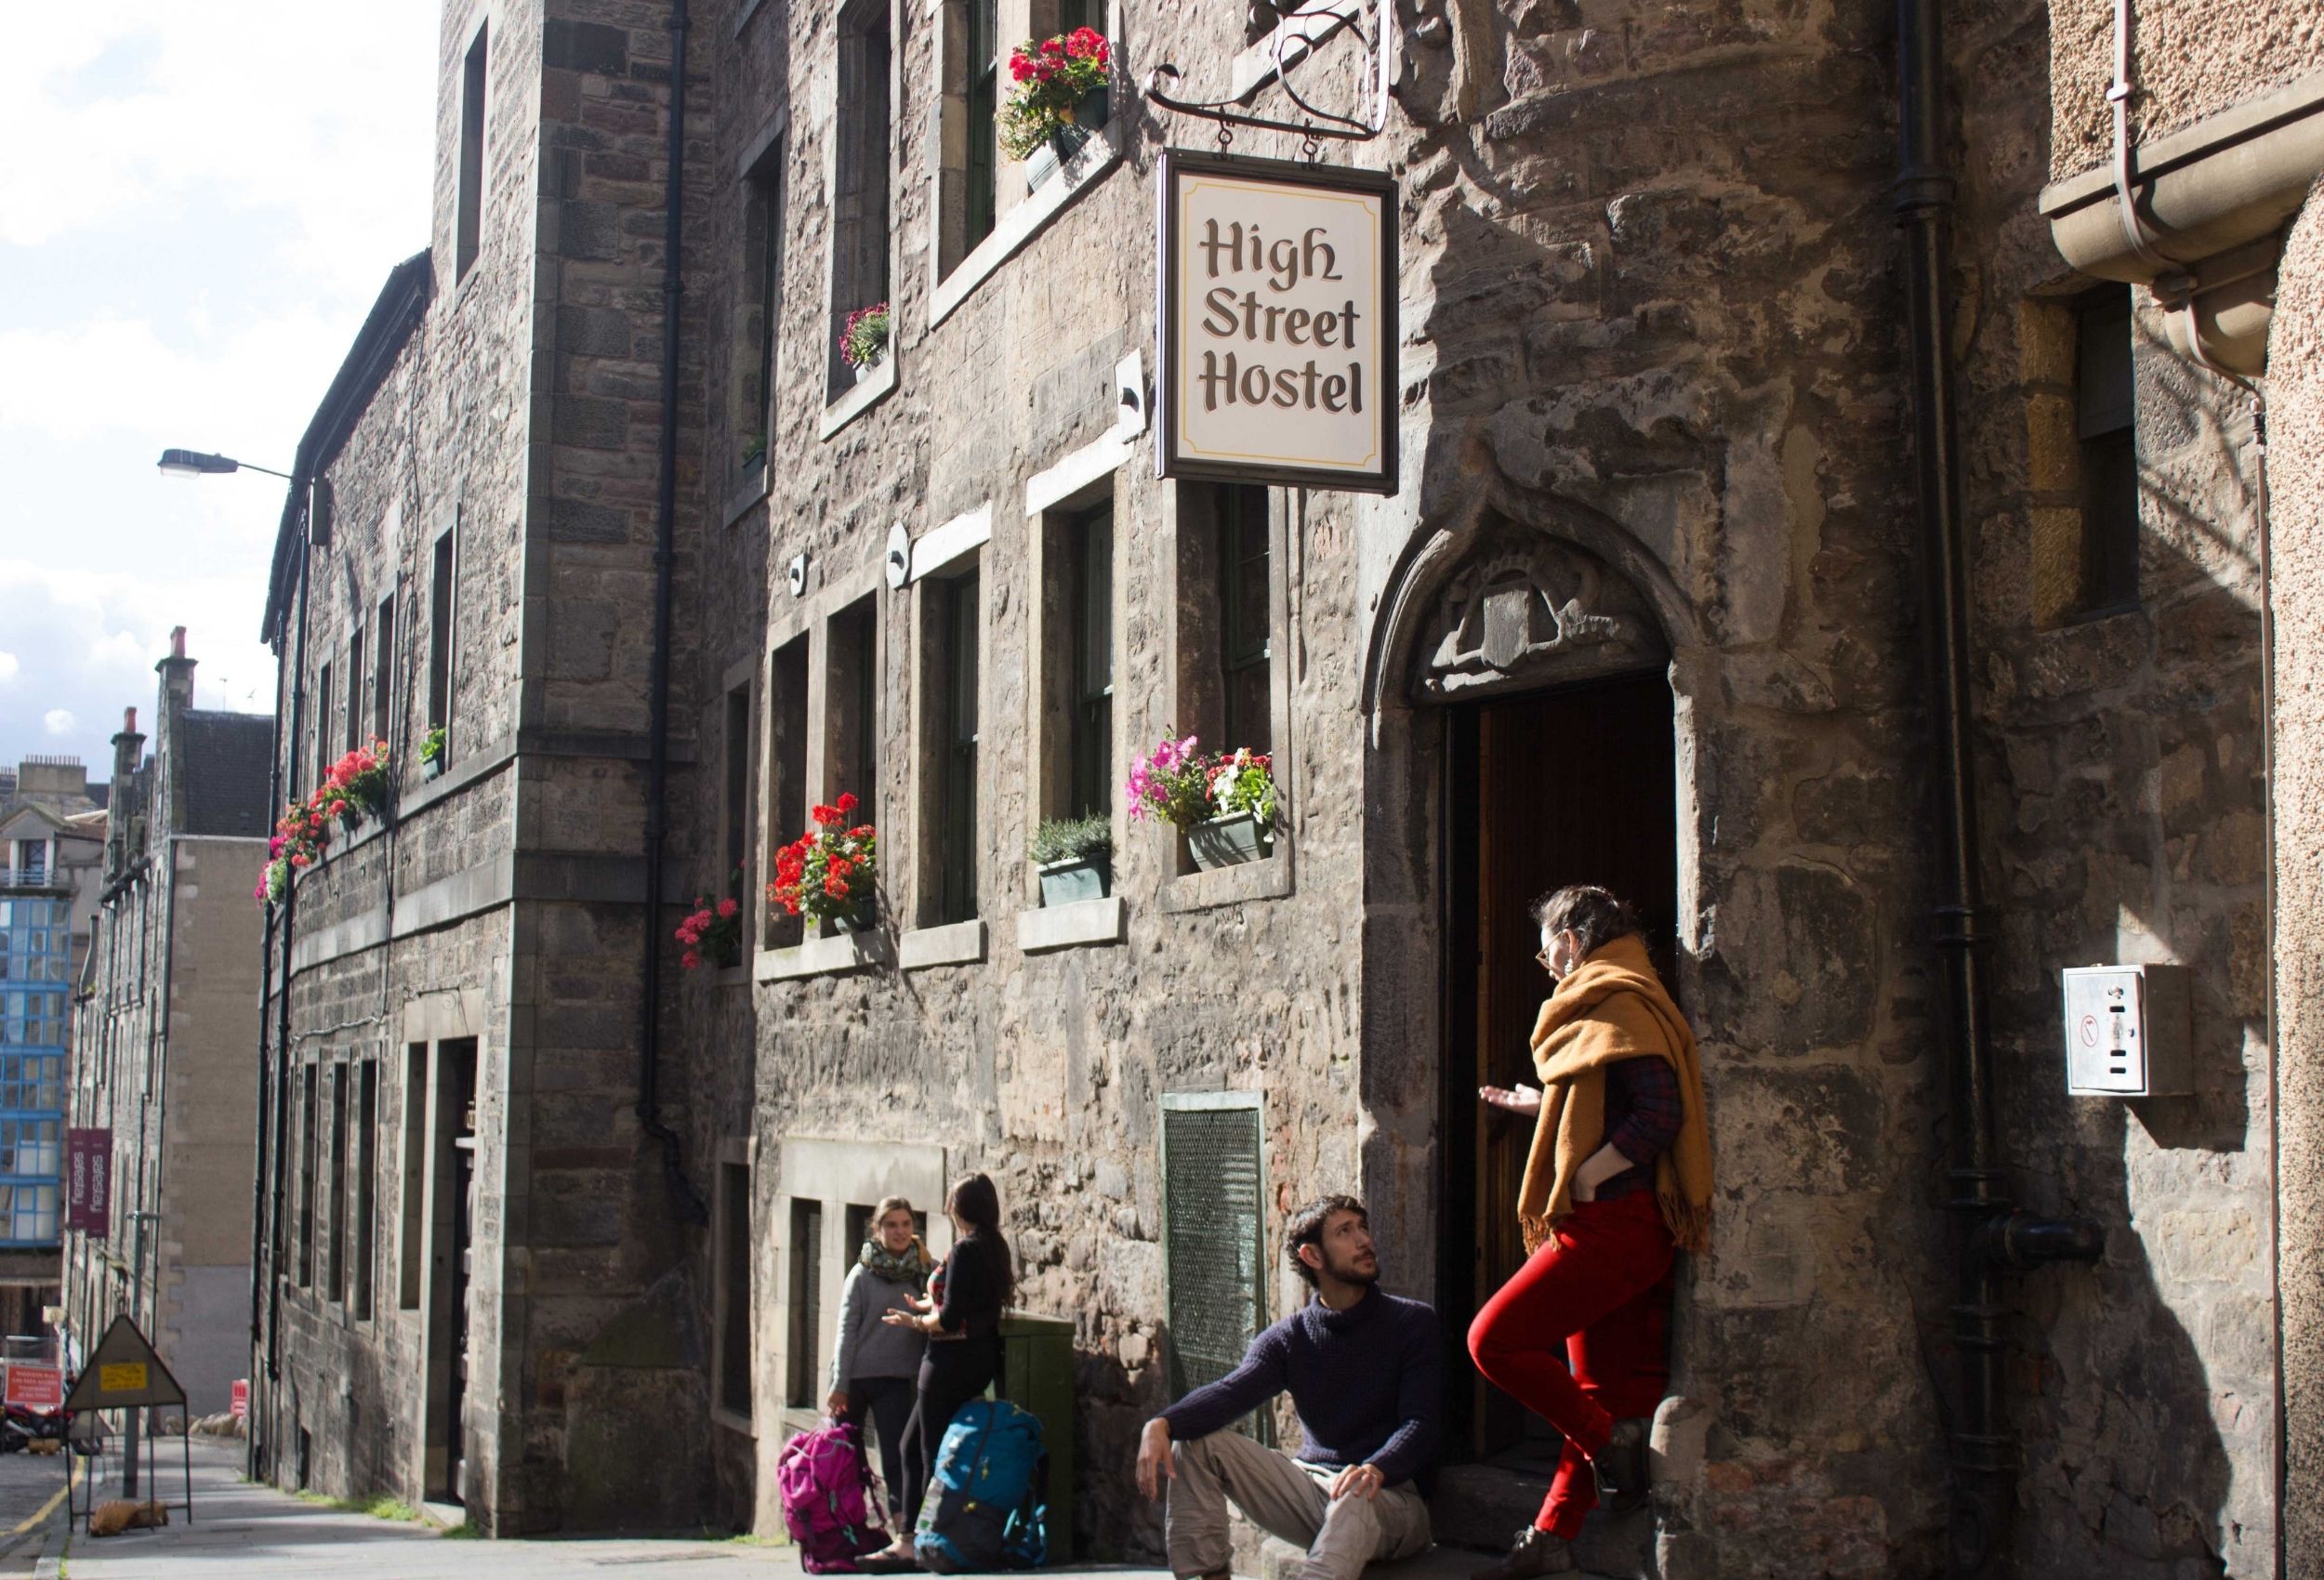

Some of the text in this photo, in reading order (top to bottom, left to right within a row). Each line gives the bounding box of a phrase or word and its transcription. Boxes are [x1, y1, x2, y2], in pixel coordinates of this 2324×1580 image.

[1198, 217, 1343, 292] High
[1201, 287, 1361, 350] Street
[1198, 349, 1363, 415] Hostel
[72, 1152, 85, 1205] safestay
[89, 1154, 105, 1213] safestay
